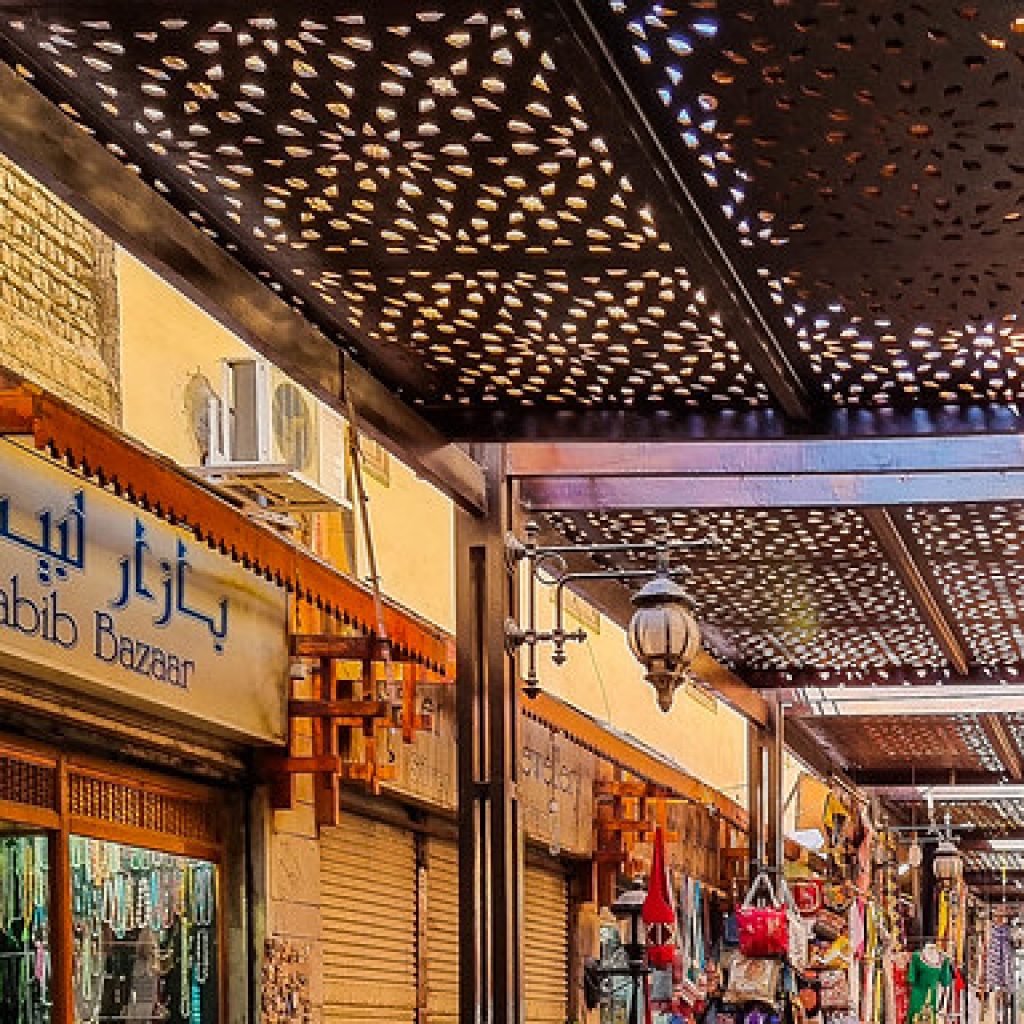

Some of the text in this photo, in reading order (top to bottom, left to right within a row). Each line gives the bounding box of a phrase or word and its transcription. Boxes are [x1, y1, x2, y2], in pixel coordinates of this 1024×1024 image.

[0, 489, 228, 653] بازار لبي
[93, 610, 195, 688] Bazaar
